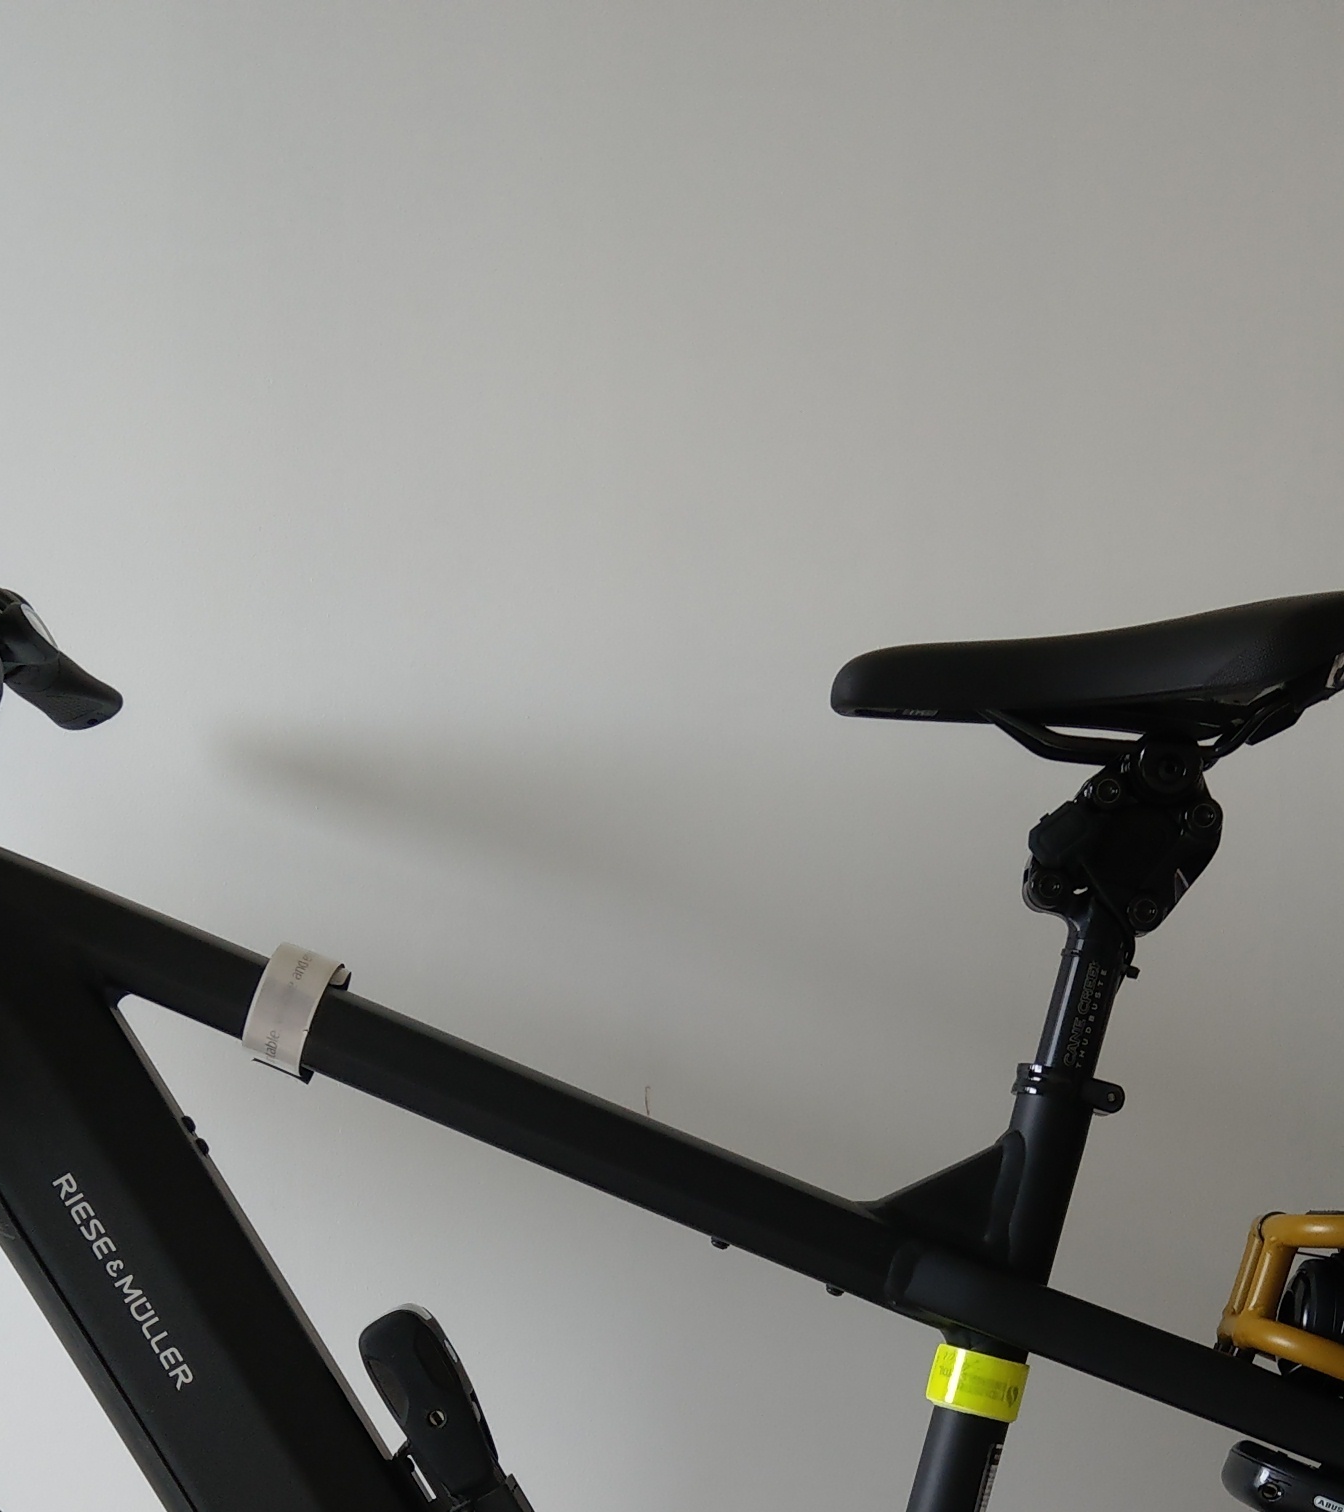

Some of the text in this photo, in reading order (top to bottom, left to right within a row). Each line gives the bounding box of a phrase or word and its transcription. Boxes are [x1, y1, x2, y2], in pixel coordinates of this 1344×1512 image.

[52, 1172, 116, 1260] RIESE
[114, 1273, 194, 1391] MÜLLER
[1317, 1499, 1344, 1512] ABUS
